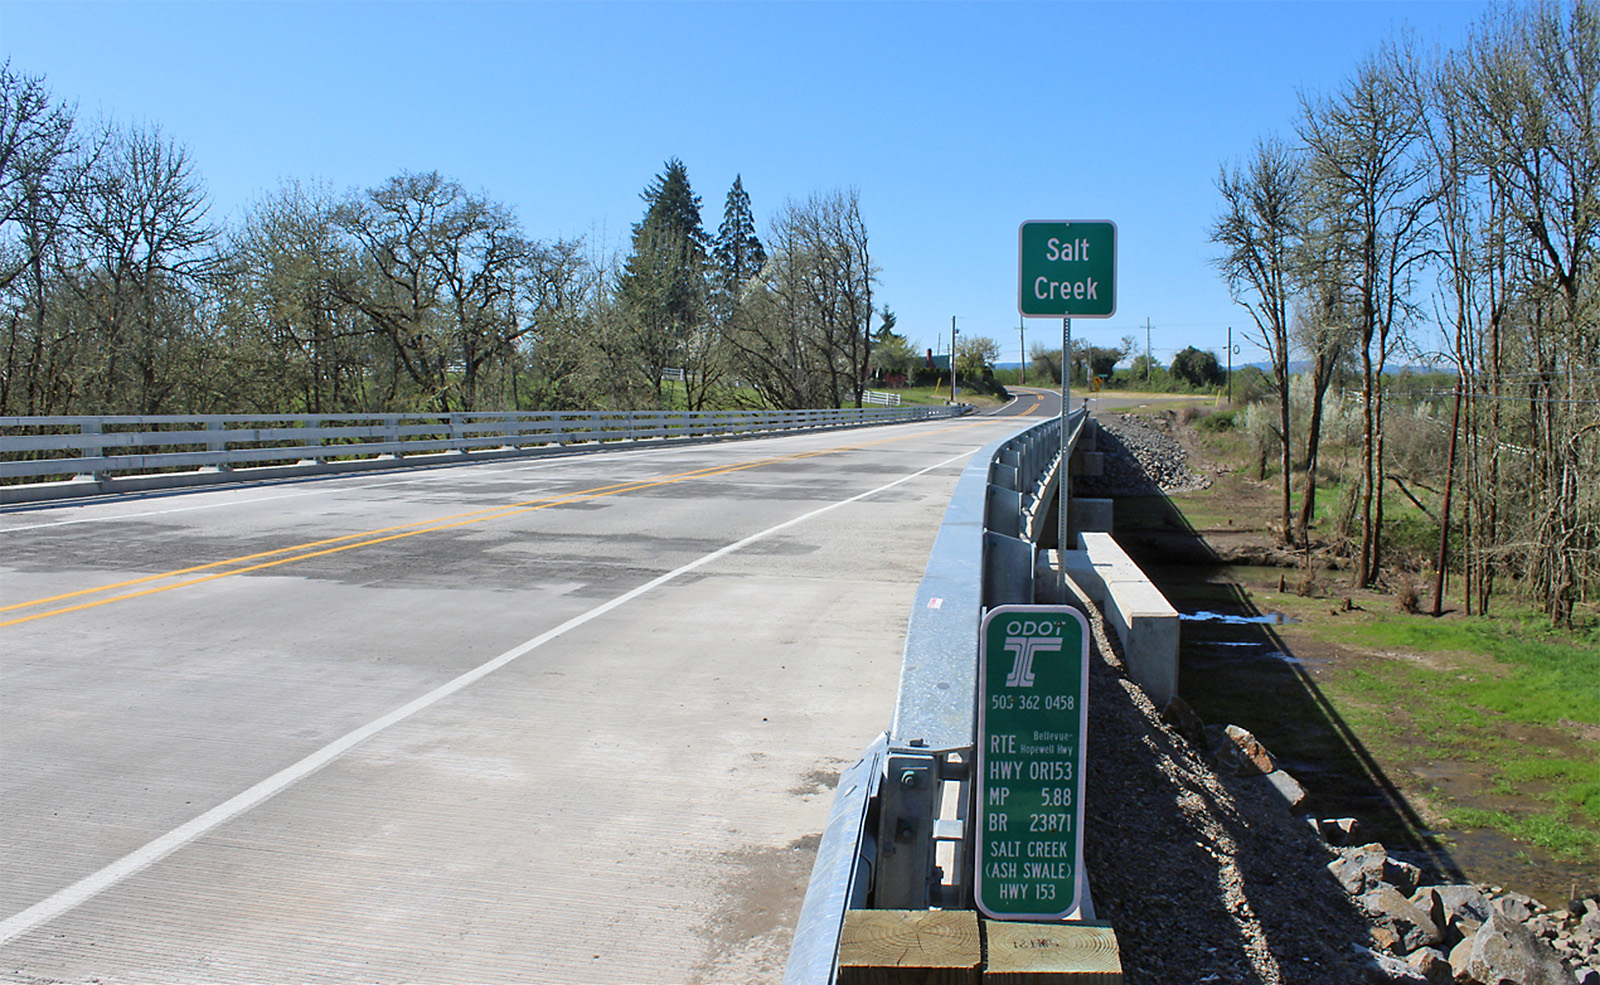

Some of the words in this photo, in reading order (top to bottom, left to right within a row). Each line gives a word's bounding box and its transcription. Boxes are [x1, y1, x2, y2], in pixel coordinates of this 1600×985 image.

[1046, 237, 1090, 261] Salt
[1034, 276, 1098, 300] Creek
[1006, 621, 1066, 636] ODOT
[992, 694, 1014, 710] 503
[1019, 695, 1040, 710] 362
[1045, 695, 1074, 710] 0458
[990, 734, 1016, 754] RTE
[1020, 744, 1054, 756] Hopewell
[1057, 744, 1073, 757] Hwy
[990, 761, 1023, 780] HWY
[1029, 761, 1073, 780] OR153
[989, 787, 1010, 806] MP
[1041, 787, 1071, 806] 5.88
[989, 813, 1008, 832] BR
[1029, 813, 1071, 832] 23871
[990, 841, 1021, 857] SALT
[1027, 841, 1067, 857] CREEK
[985, 862, 1017, 878] (ASH
[1023, 862, 1071, 879] SWALE)
[999, 884, 1028, 899] HWY
[1036, 884, 1056, 899] 153
